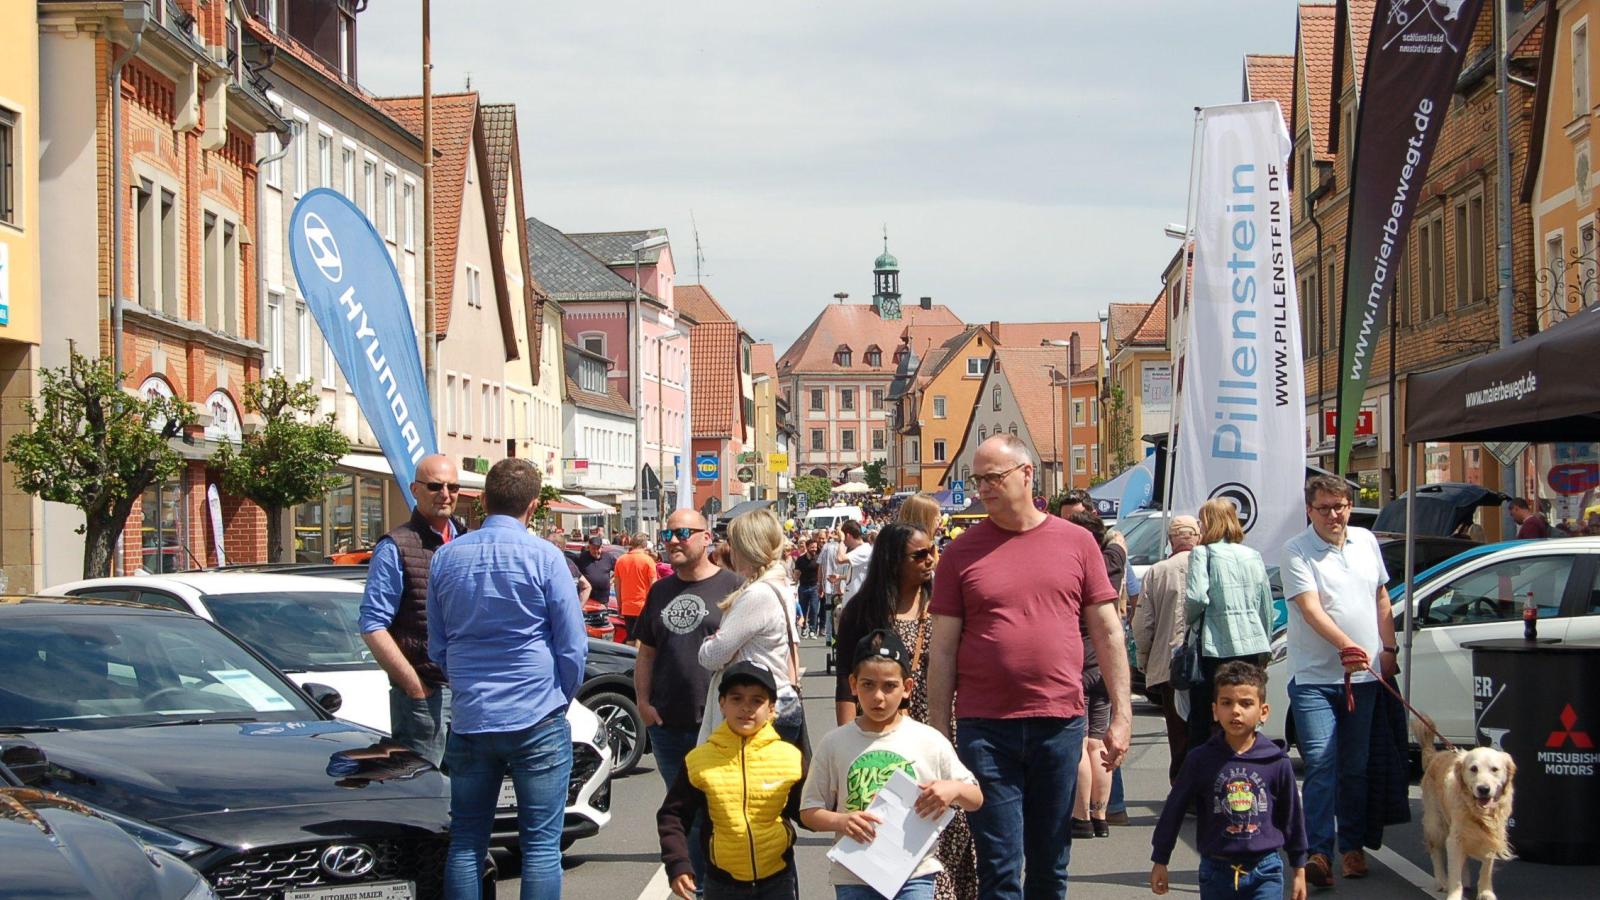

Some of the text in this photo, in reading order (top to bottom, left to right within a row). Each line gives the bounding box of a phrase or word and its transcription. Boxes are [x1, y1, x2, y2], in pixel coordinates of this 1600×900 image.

[1350, 97, 1434, 380] www.maierbewegt.de
[1211, 163, 1258, 462] Pillenstein
[339, 285, 426, 464] HYUNDAI
[1464, 370, 1537, 408] www.maierbewegt.de
[660, 609, 710, 617] SCOTLAND
[1545, 764, 1594, 776] MOTORS
[358, 890, 384, 899] MAIER
